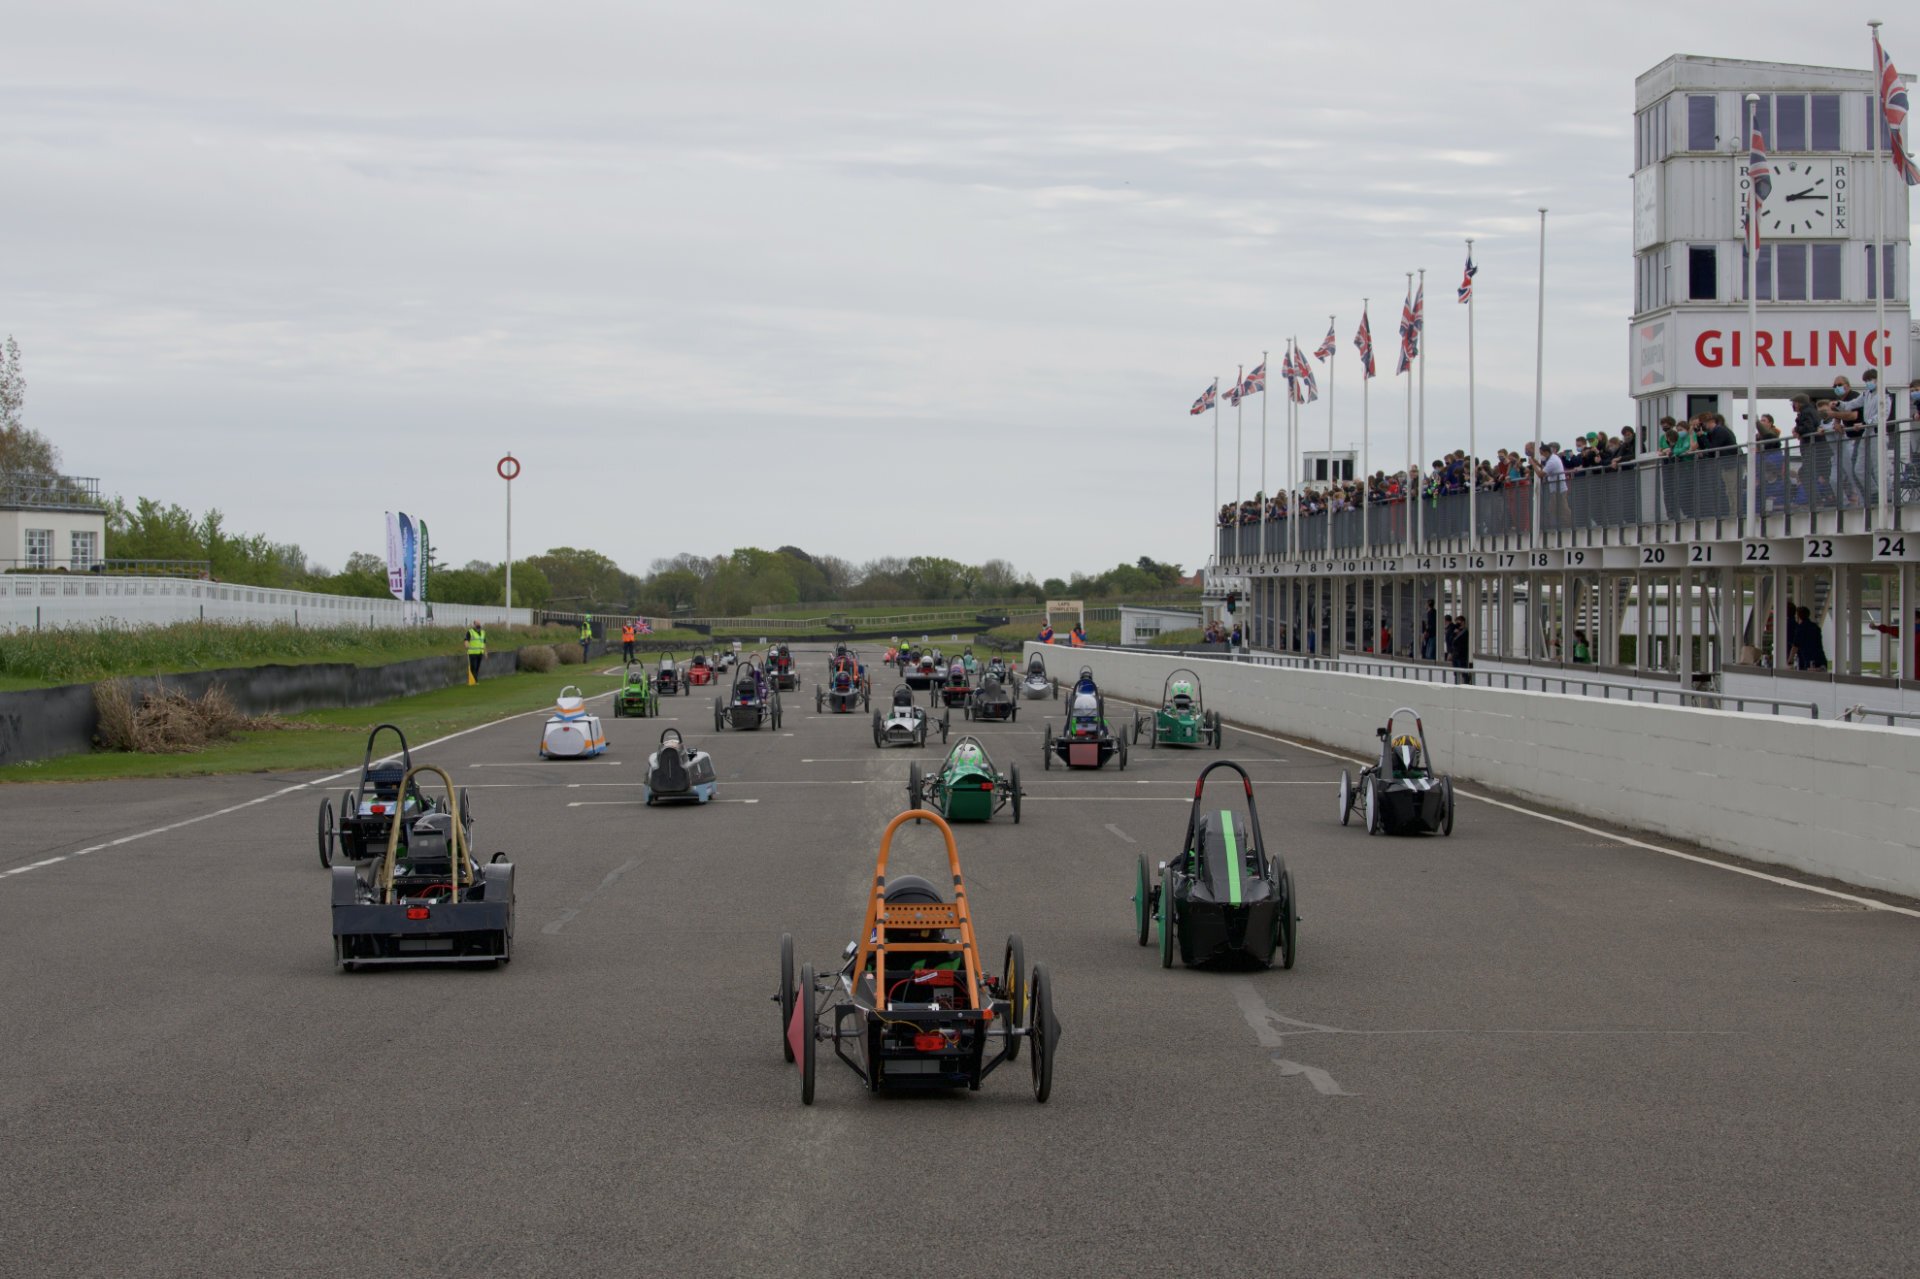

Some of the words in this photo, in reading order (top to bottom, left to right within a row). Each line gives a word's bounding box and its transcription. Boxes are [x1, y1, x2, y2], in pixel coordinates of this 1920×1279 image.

[1835, 166, 1846, 229] ROLEX
[1694, 329, 1892, 368] GIRLING
[1745, 544, 1770, 561] 22
[1808, 540, 1833, 558] 23
[1878, 537, 1906, 557] 24
[1567, 551, 1584, 565] 19
[1643, 548, 1665, 563] 20
[1691, 546, 1712, 562] 21
[1383, 560, 1396, 571] 12
[1417, 558, 1431, 569] 14
[1442, 557, 1457, 569] 15
[1469, 556, 1484, 568] 16
[1499, 555, 1515, 567] 17
[1532, 553, 1548, 567] 18
[1224, 567, 1229, 575] 2
[1235, 567, 1240, 575] 3
[1247, 567, 1253, 575] 4
[1260, 566, 1265, 574] 5
[1273, 565, 1279, 574] 6
[1294, 564, 1300, 573] 7
[1310, 563, 1317, 573] 8
[1326, 562, 1333, 572] 9
[1343, 561, 1356, 572] 10
[1363, 561, 1374, 571] 11
